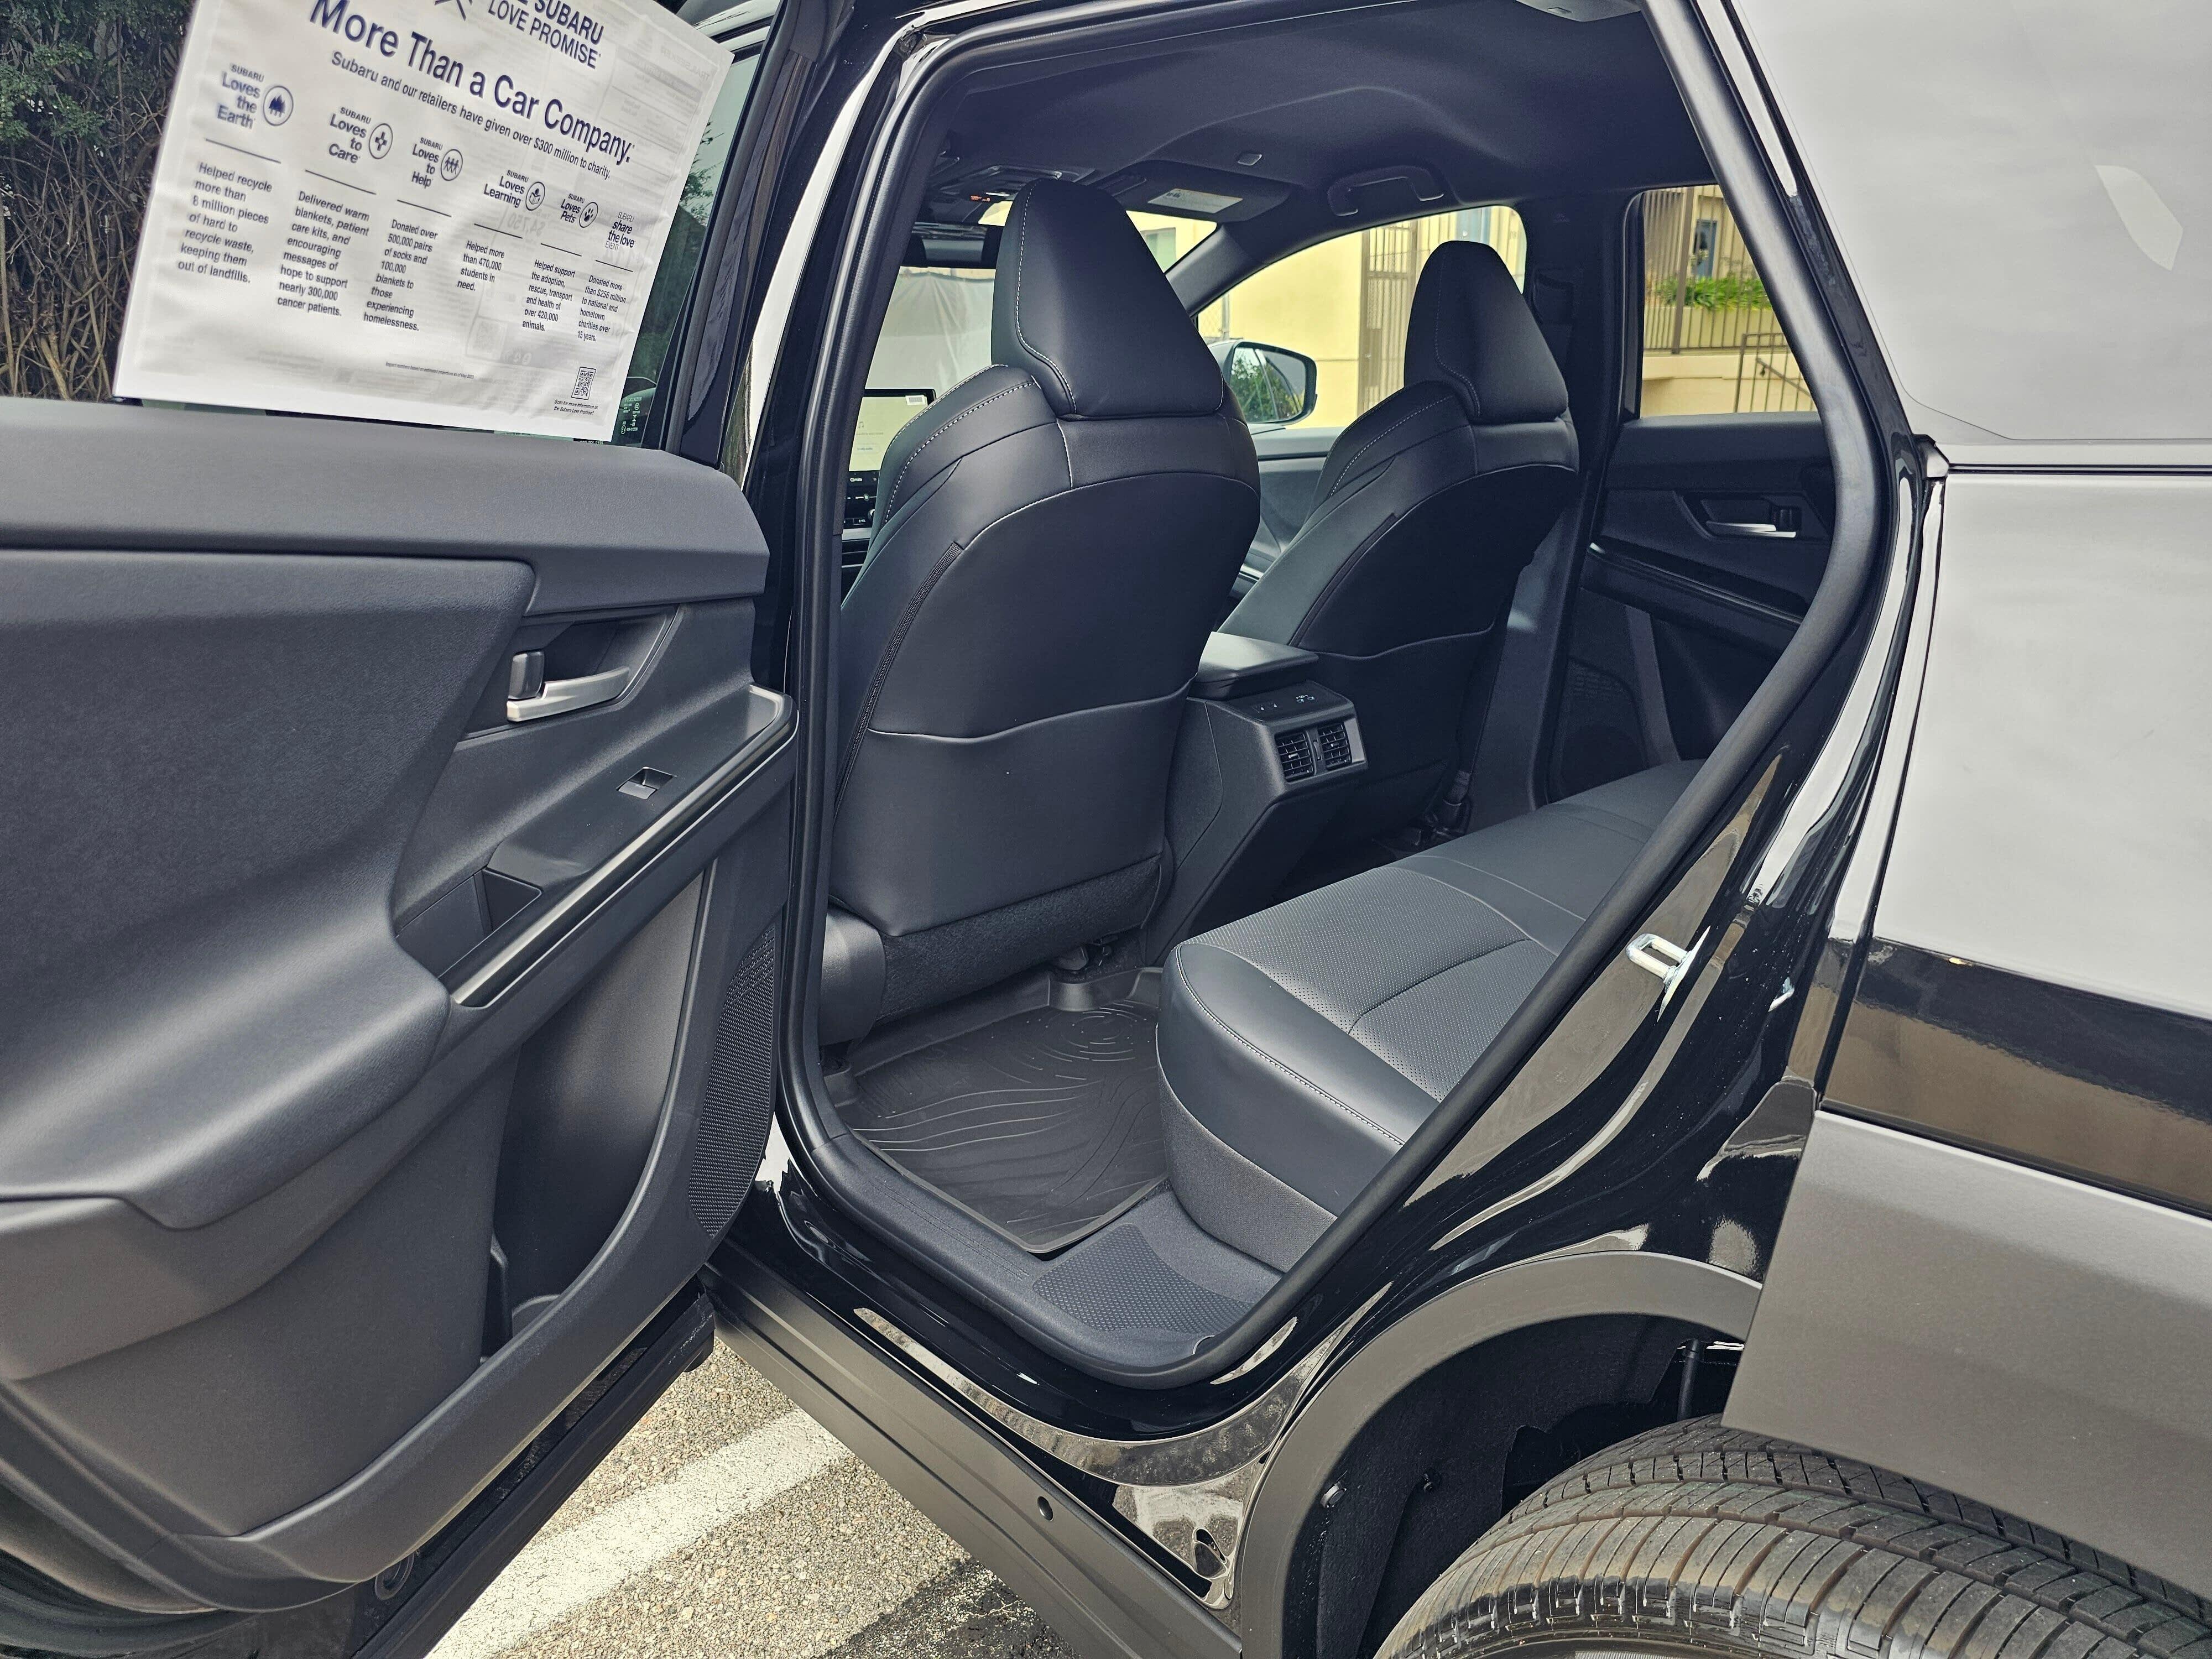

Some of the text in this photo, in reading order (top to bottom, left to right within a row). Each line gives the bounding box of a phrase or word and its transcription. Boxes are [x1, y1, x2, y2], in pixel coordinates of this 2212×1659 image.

[488, 0, 529, 32] LOVE
[534, 0, 604, 45] SUBARU
[231, 63, 264, 82] SUBARU
[222, 71, 260, 98] Loves
[310, 0, 632, 165] More Than a Car Company.
[237, 95, 257, 113] the
[216, 103, 254, 129] Earth
[331, 51, 610, 179] Subaru and our retailers have given over $300 million to charity.
[340, 107, 372, 124] SUBARU
[330, 113, 367, 138] Loves
[349, 138, 362, 151] to
[420, 137, 443, 150] SUBARU
[328, 143, 358, 164] Care
[412, 144, 440, 163] Loves
[198, 162, 272, 192] Helped recycle
[426, 163, 435, 175] to
[507, 170, 529, 182] SUBARU
[411, 171, 431, 189] Help
[499, 176, 525, 194] Loves
[194, 180, 247, 202] more than
[483, 184, 521, 208] Learning
[568, 194, 585, 204] SUBARU
[192, 195, 269, 224] 8 million pieces
[298, 191, 370, 222] Delivered warm
[560, 199, 581, 214] Loves
[189, 213, 238, 232] of hard to
[295, 206, 369, 236] blankets, patient
[560, 211, 576, 223] Pets
[618, 212, 634, 222] SUBARU
[291, 223, 351, 245] care kits, and
[392, 219, 438, 240] Donated over
[612, 220, 633, 234] share
[185, 229, 254, 254] recycle waste,
[287, 237, 342, 259] encouraging
[388, 233, 433, 252] 500,000 pairs
[605, 241, 619, 251] EVENT
[608, 230, 635, 248] the love
[180, 243, 247, 266] keeping them
[384, 248, 427, 264] of socks and
[466, 241, 504, 258] Helped more
[283, 251, 338, 271] messages of
[380, 260, 406, 274] 100,000
[463, 253, 502, 271] than 470,000
[534, 259, 575, 278] Helped support
[178, 260, 250, 283] out of landfills.
[280, 264, 348, 288] hope to support
[461, 267, 495, 283] students in
[531, 272, 565, 288] the adoption,
[375, 273, 414, 289] blankets to
[457, 280, 476, 291] need.
[588, 275, 622, 291] Donated more
[279, 281, 338, 301] nearly 300,000
[371, 286, 393, 299] those
[529, 284, 572, 301] rescue, transport
[585, 286, 626, 303] than $256 million
[277, 296, 342, 316] cancer patients.
[367, 300, 414, 318] experiencing
[526, 296, 536, 305] and
[538, 298, 554, 307] health
[588, 299, 608, 310] national
[363, 312, 419, 331] homelessness.
[538, 310, 559, 322] 420,000
[580, 307, 604, 320] hometown
[523, 321, 546, 332] animals.
[578, 320, 598, 330] charities
[584, 333, 596, 341] years.
